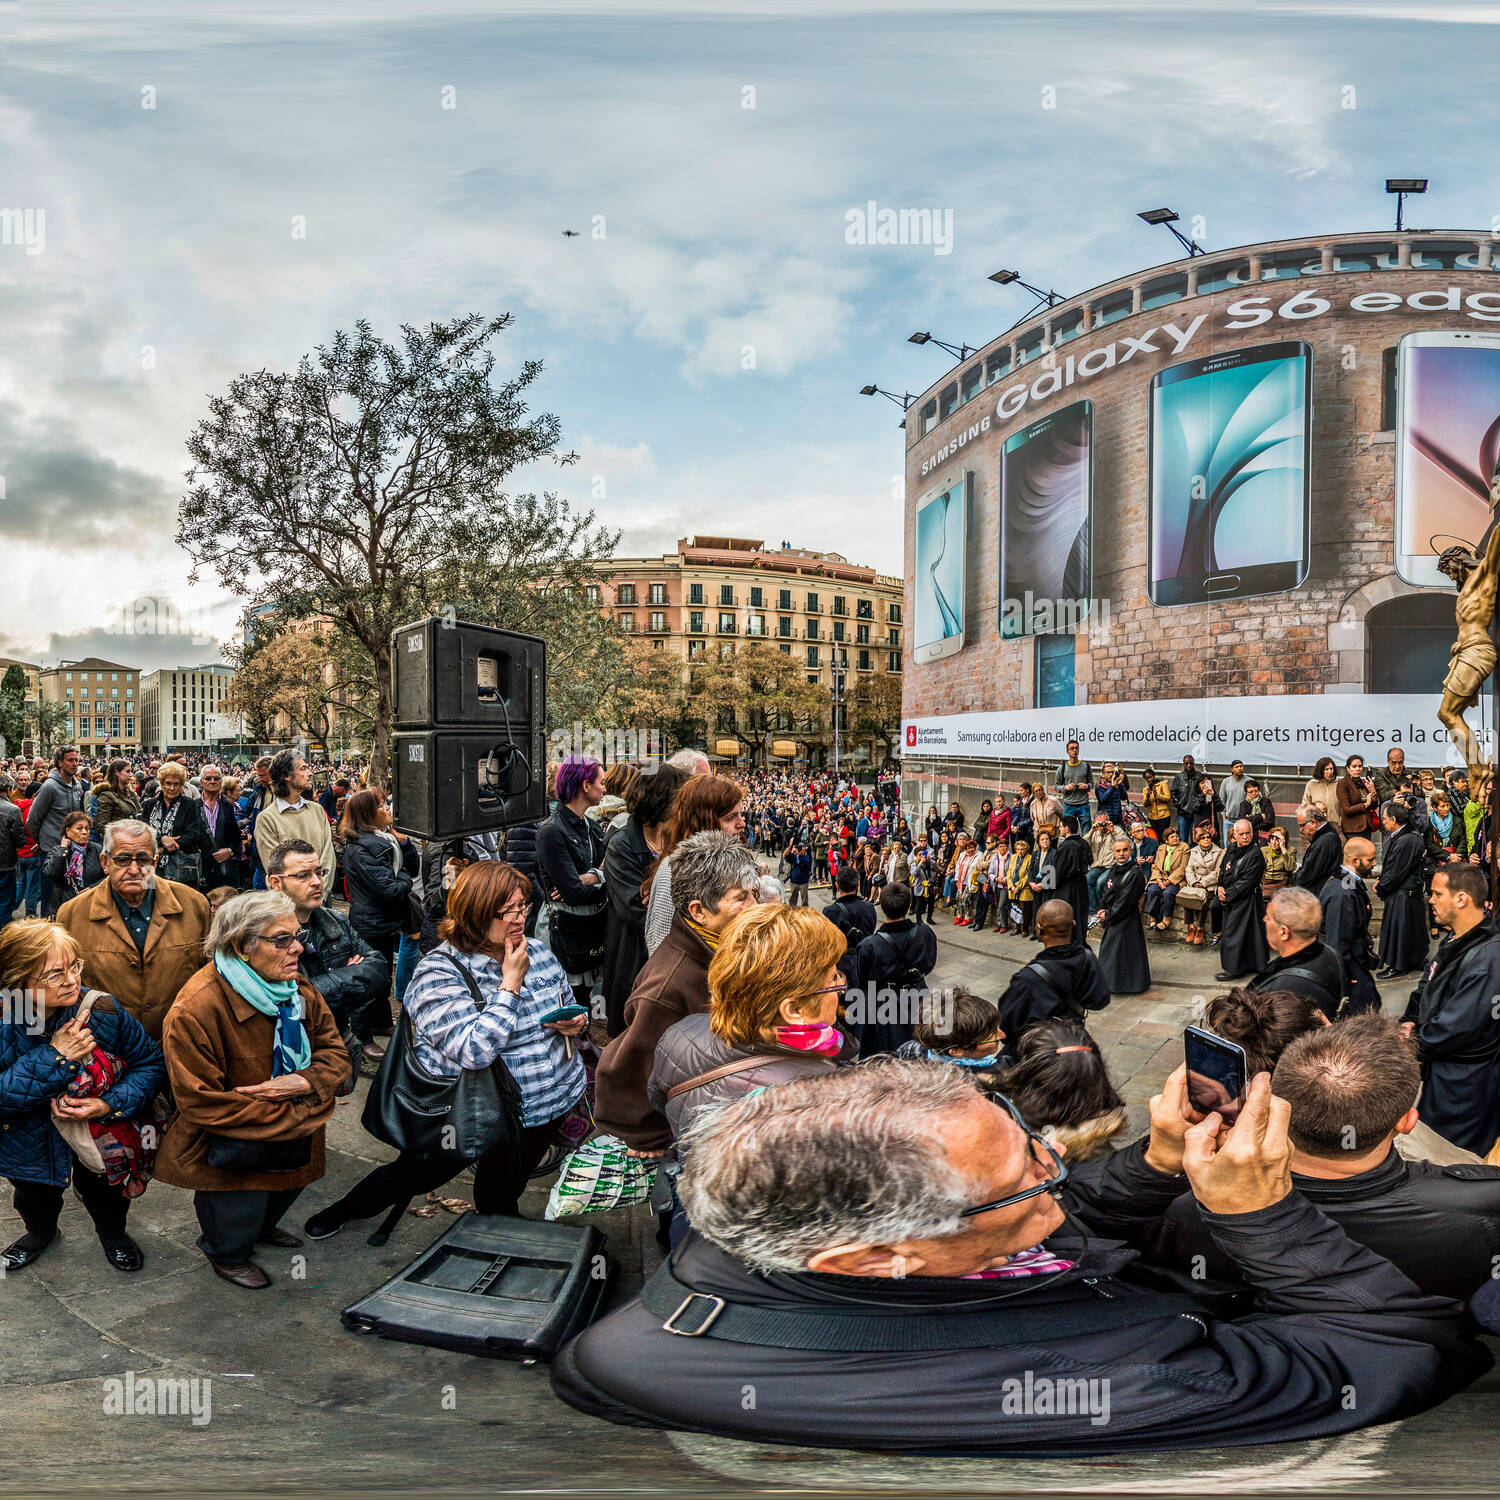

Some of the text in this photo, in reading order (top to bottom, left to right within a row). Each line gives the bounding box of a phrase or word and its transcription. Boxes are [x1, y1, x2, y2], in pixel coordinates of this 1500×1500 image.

[921, 415, 991, 477] SAMSUNG
[996, 313, 1209, 419] Galaxy
[1224, 289, 1331, 329] S6
[957, 731, 991, 745] Samsung
[1039, 733, 1053, 742] en
[1055, 729, 1065, 742] el
[1068, 728, 1085, 742] Pla
[1088, 727, 1105, 742] de
[1109, 725, 1201, 742] remodelació
[1206, 724, 1228, 742] de
[1233, 726, 1290, 746] parets
[1297, 723, 1385, 746] mitgeres
[1391, 729, 1402, 743] a
[1409, 724, 1425, 743] la
